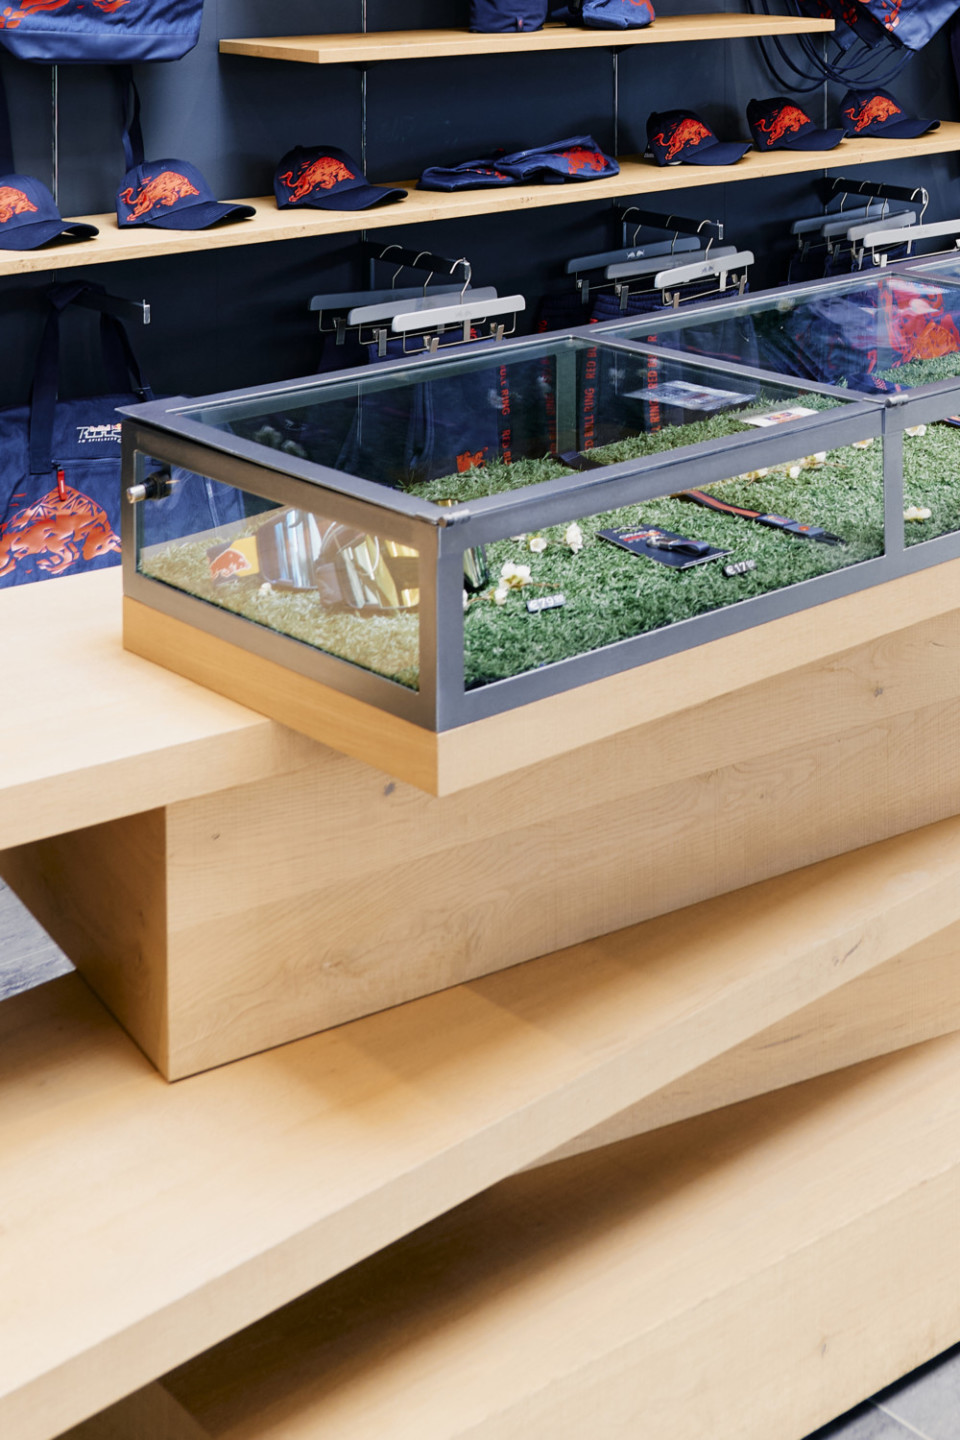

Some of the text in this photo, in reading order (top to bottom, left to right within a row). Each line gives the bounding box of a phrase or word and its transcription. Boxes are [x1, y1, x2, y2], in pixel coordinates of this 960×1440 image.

[585, 361, 597, 379] RED
[647, 370, 658, 390] RED
[501, 389, 511, 416] RING
[584, 388, 596, 413] RING
[584, 414, 594, 437] BULL
